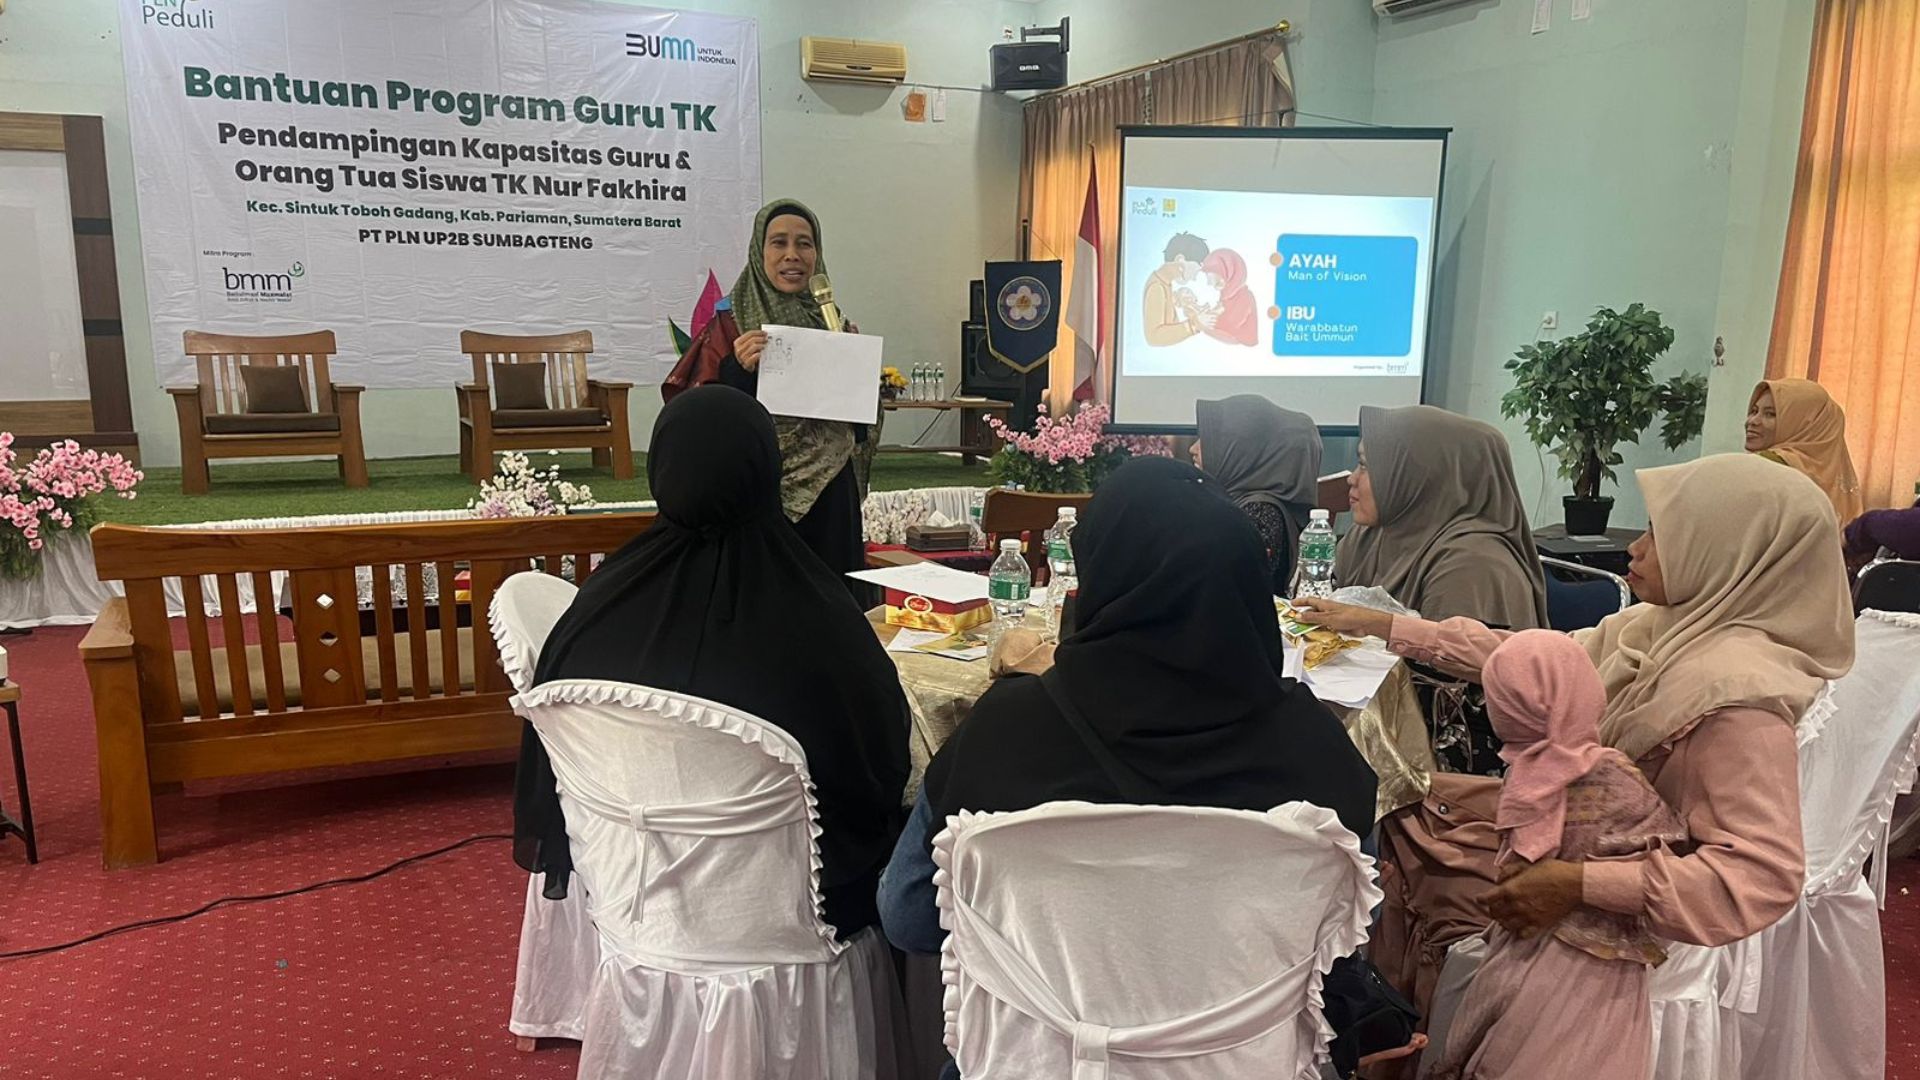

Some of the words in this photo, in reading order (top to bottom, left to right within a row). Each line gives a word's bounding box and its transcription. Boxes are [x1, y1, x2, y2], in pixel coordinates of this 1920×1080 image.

[143, 4, 214, 29] Peduli
[626, 33, 695, 61] BUMN
[697, 47, 722, 56] UNTUK
[697, 55, 737, 66] INDONESIA
[184, 66, 378, 109] Bantuan
[386, 80, 565, 126] Program
[573, 95, 664, 129] Guru
[671, 102, 717, 132] TK
[218, 122, 456, 161] Pendampingan
[461, 137, 602, 168] Kapasitas
[607, 146, 670, 169] Guru
[675, 150, 692, 170] &
[235, 159, 334, 192] Orang
[338, 164, 397, 189] Tua
[402, 166, 487, 193] Siswa
[491, 173, 528, 195] TK
[533, 175, 582, 197] Nur
[587, 178, 686, 201] Fakhira
[246, 200, 283, 214] Kec.
[285, 201, 339, 216] Sintuk
[341, 204, 391, 218] Toboh
[393, 206, 458, 224] Gadang,
[460, 209, 494, 222] Kab.
[496, 210, 572, 227] Pariaman,
[574, 213, 642, 227] Sumatera
[645, 216, 682, 228] Barat
[358, 229, 381, 243] PT
[385, 230, 420, 245] PLN
[423, 231, 469, 246] UP2B
[472, 233, 593, 250] SUMBAGTENG
[1288, 253, 1338, 269] AYAH
[221, 266, 292, 291] bmm
[1288, 271, 1313, 281] Man
[1316, 271, 1330, 281] of
[1333, 271, 1367, 281] Vision
[1286, 305, 1316, 321] IBU
[1285, 322, 1358, 332] Warabbatun
[1285, 332, 1309, 342] Bait
[1312, 332, 1354, 342] Ummun
